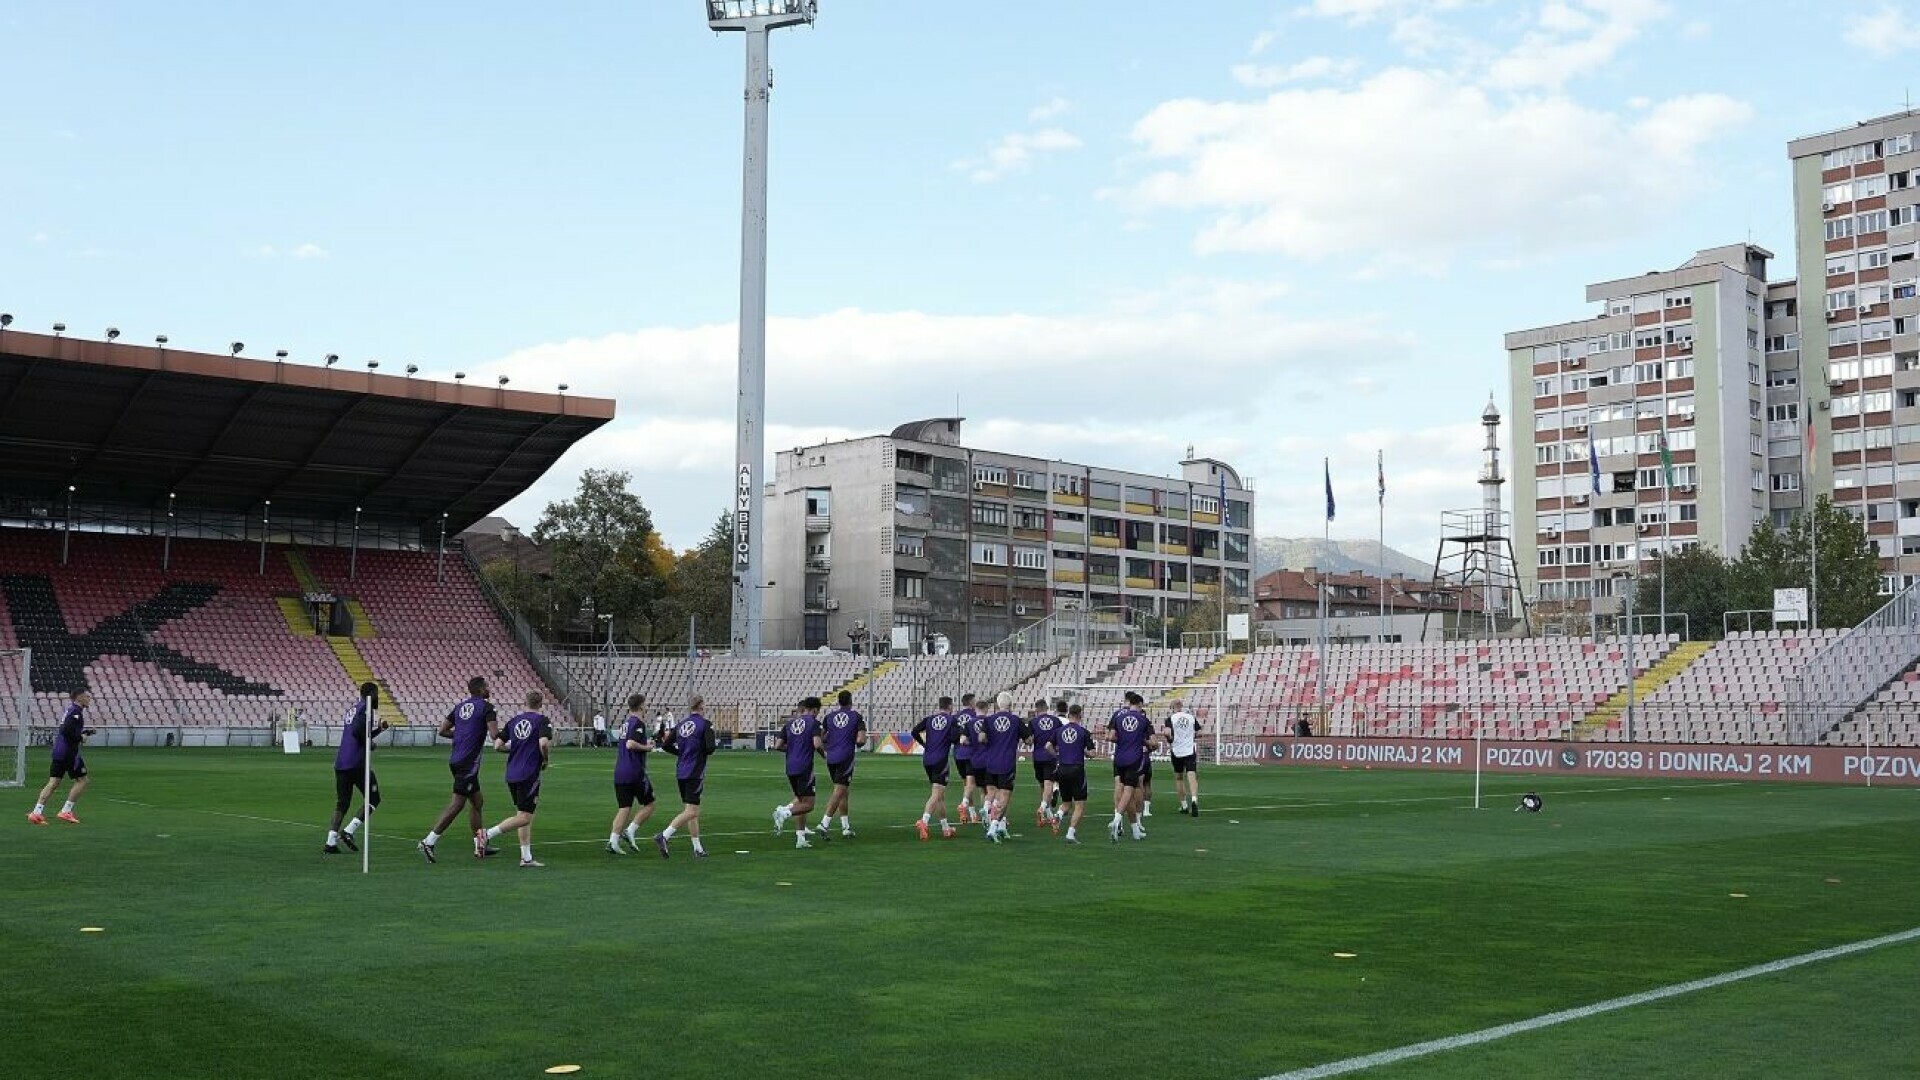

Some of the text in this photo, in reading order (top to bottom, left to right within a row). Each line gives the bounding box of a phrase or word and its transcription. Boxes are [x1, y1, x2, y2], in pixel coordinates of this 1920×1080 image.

[738, 465, 750, 564] ALMY BETON
[513, 719, 532, 740] VW
[833, 712, 850, 729] VW
[994, 715, 1011, 732] VW
[1039, 716, 1054, 731] VW
[1122, 715, 1139, 732] VW
[1061, 727, 1078, 744] VW
[1218, 742, 1267, 759] POZOVI
[1290, 744, 1333, 761] 17039
[1347, 745, 1417, 764] DONIRAJ
[1421, 747, 1432, 763] 2
[1436, 747, 1462, 765] KM
[1486, 748, 1811, 775] POZOVI 17039 i DONIRAJ 2 KM
[1844, 755, 1920, 778] POZOV
